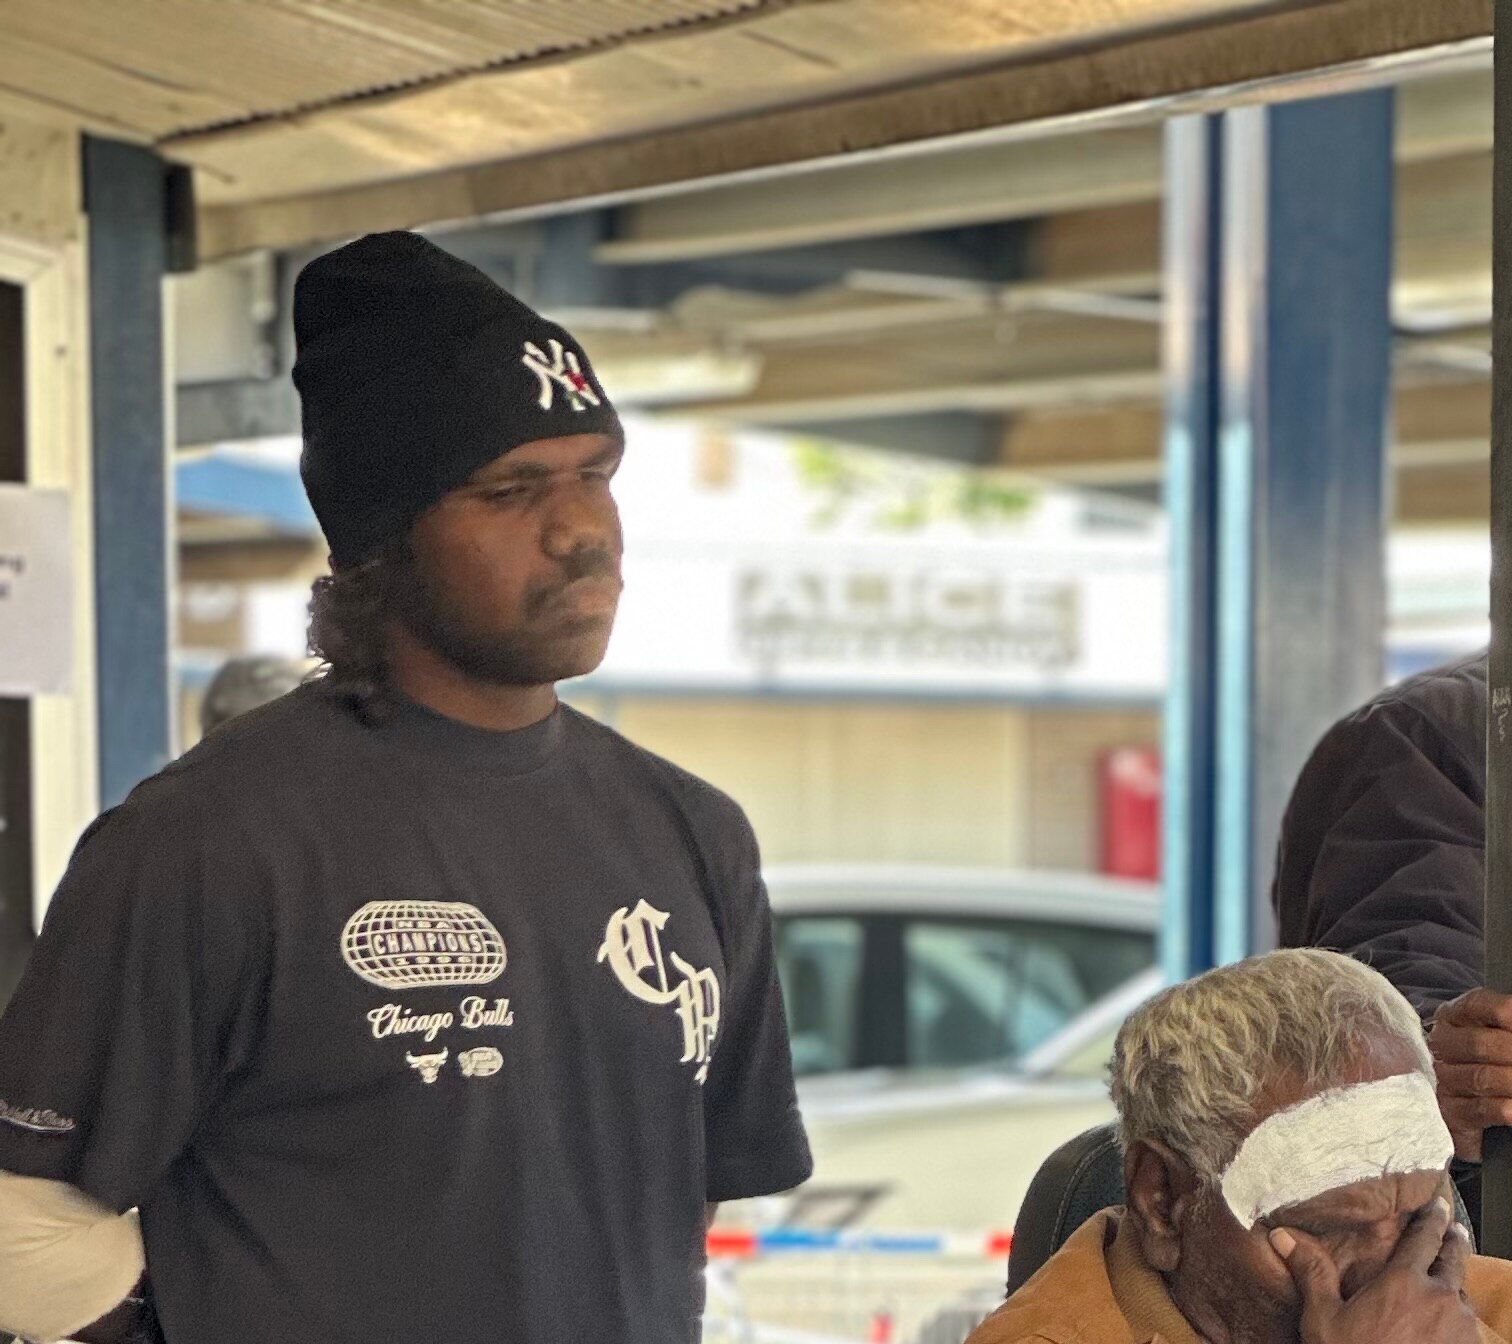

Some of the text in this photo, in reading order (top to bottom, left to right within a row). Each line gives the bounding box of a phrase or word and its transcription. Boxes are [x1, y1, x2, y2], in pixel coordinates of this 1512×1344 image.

[373, 932, 483, 955] CHAMPIONS
[366, 995, 515, 1042] Chicago Bulls
